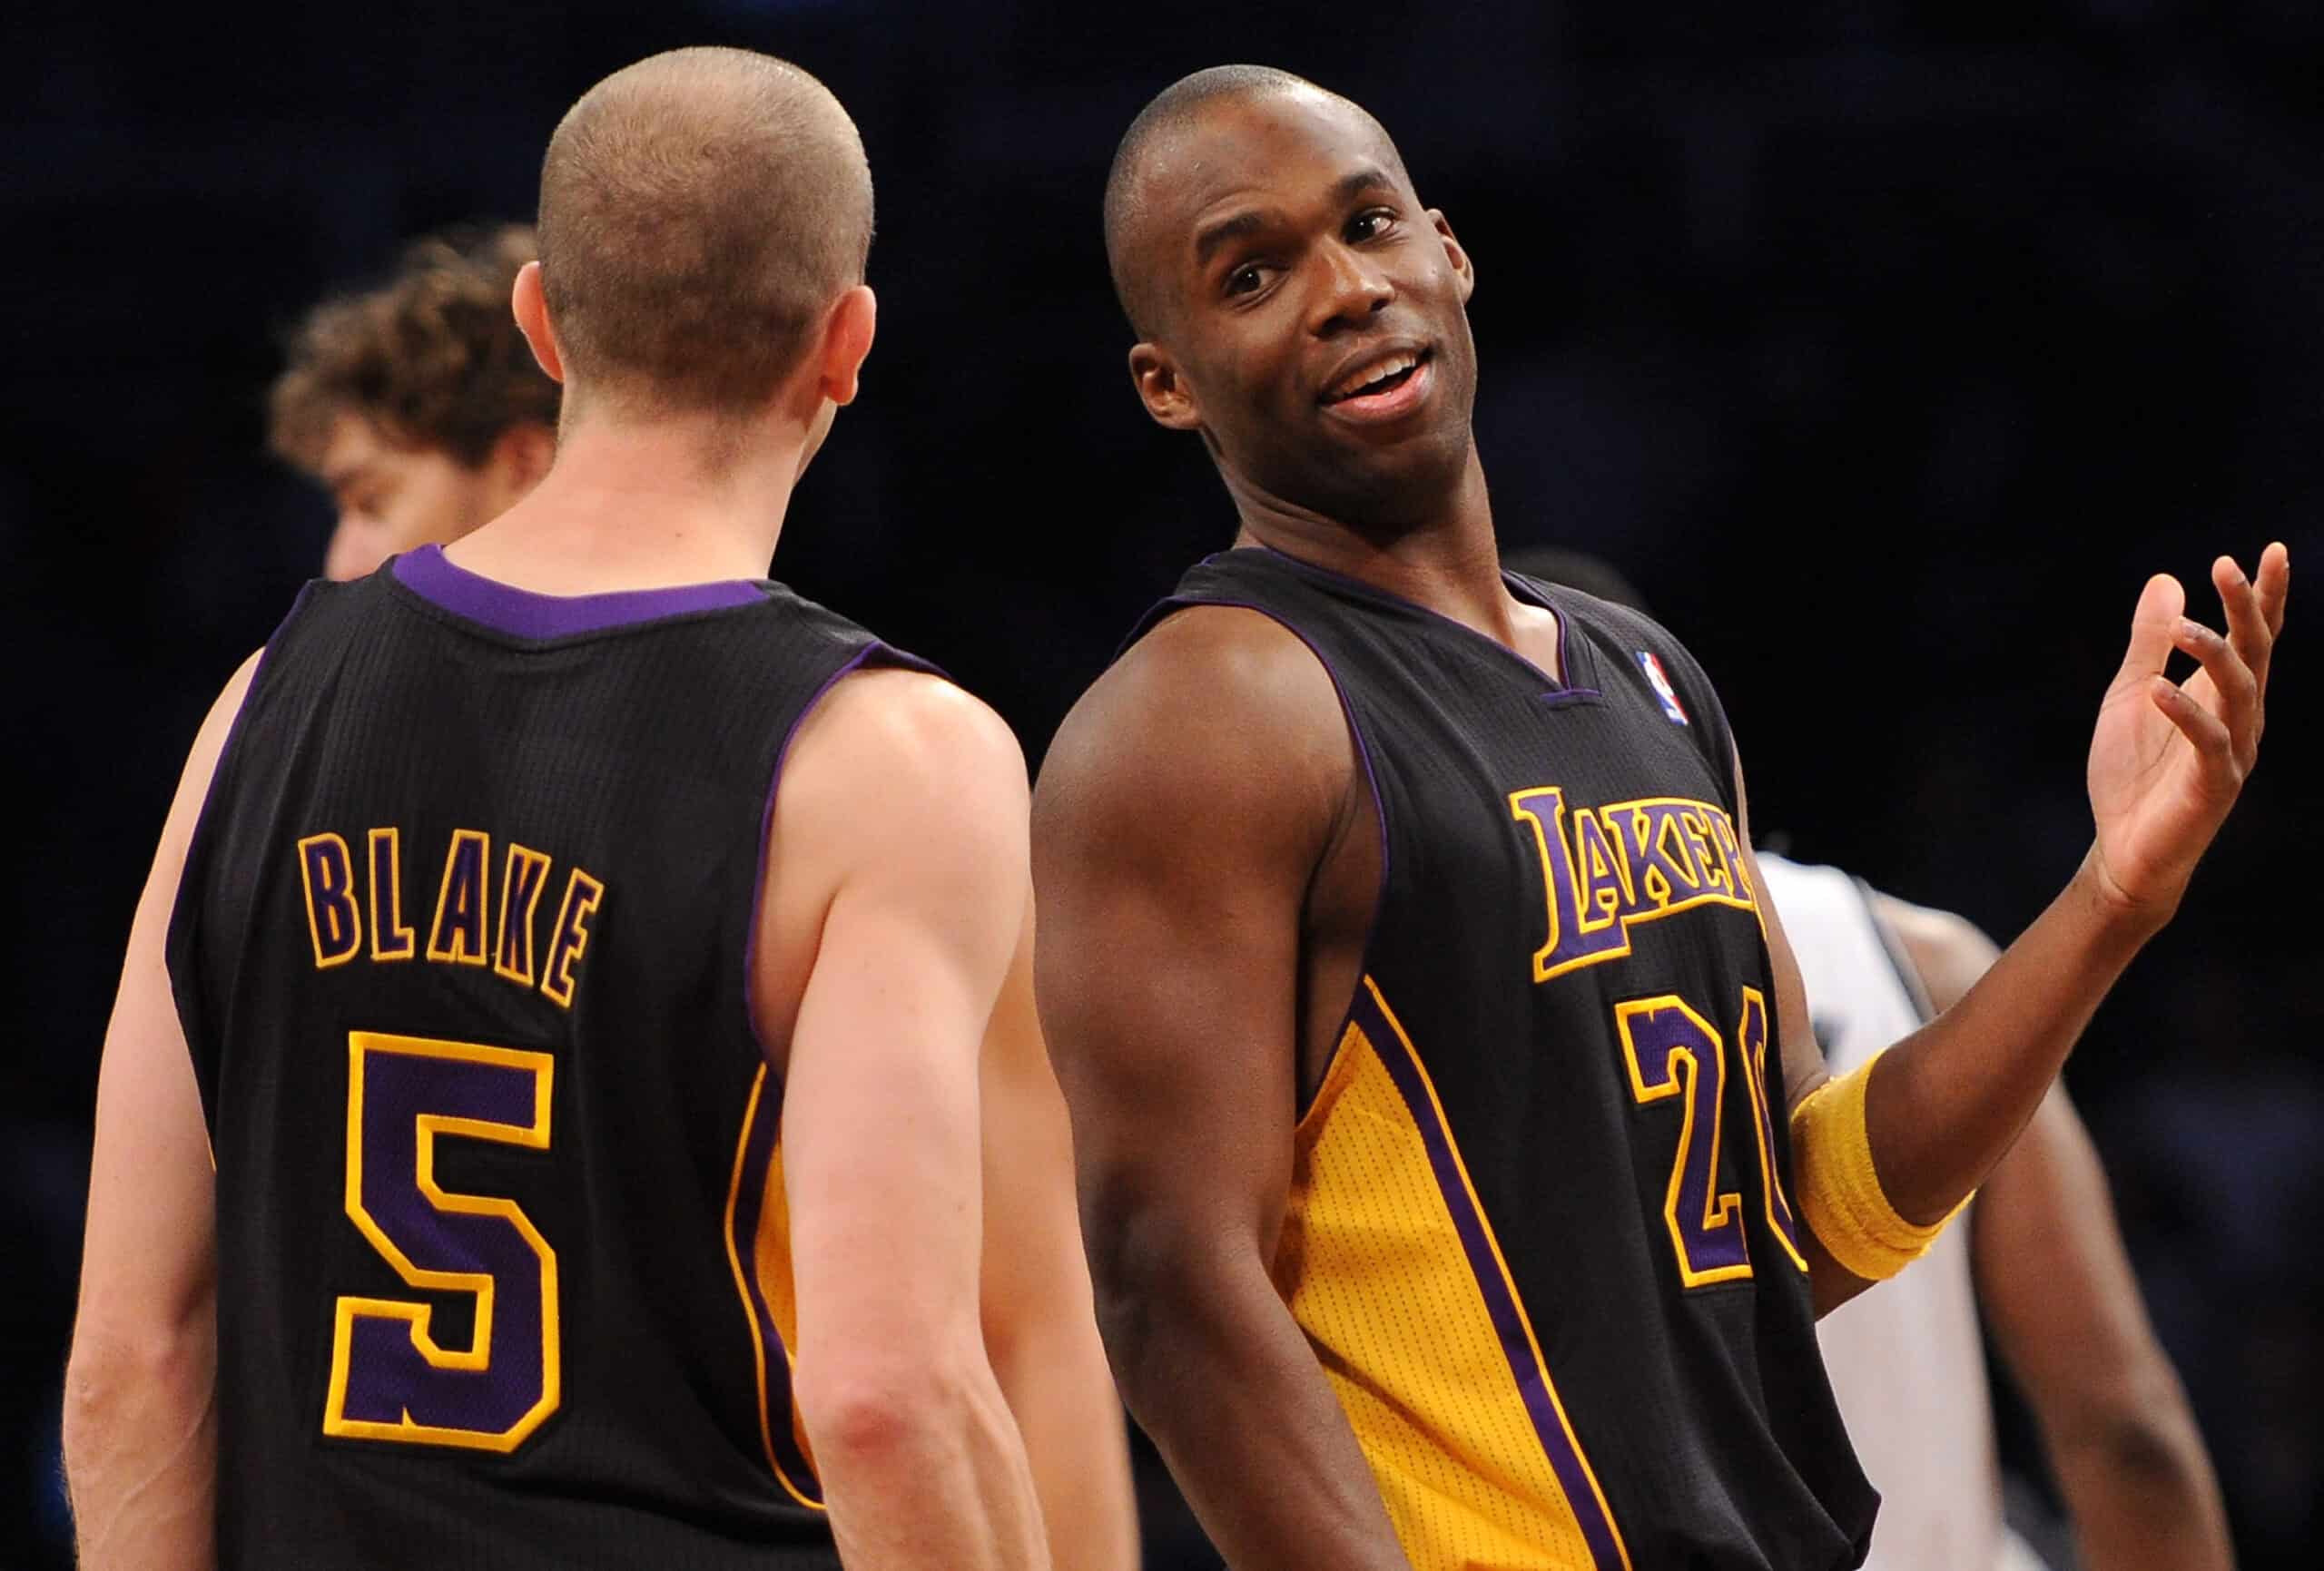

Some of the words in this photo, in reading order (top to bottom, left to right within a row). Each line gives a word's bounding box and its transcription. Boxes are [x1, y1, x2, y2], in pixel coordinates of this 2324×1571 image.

[298, 827, 603, 1007] BLAKE
[1508, 786, 1766, 983] LAKER
[322, 1031, 560, 1453] 5
